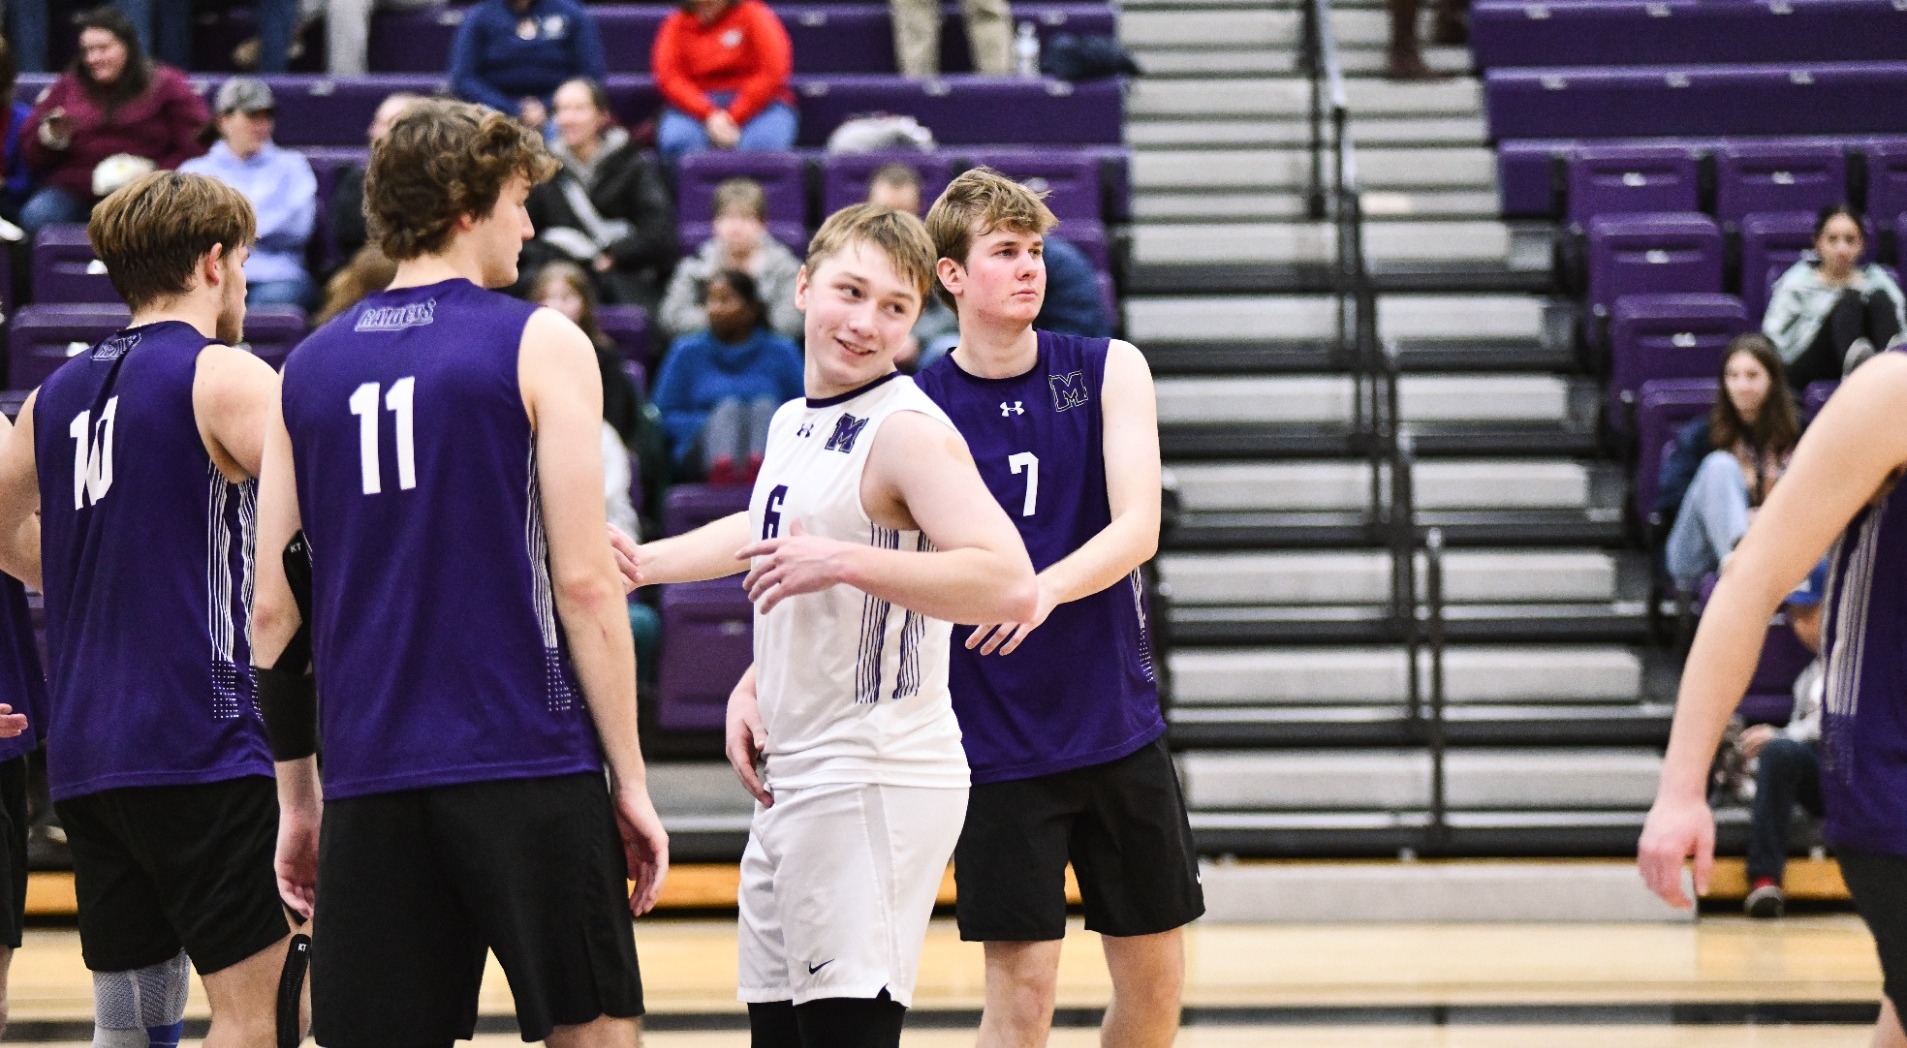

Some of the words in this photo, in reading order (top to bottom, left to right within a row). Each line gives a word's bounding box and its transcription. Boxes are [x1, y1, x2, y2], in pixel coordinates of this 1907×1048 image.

[1048, 370, 1088, 412] M
[70, 395, 118, 510] 10
[349, 376, 416, 495] 11
[824, 412, 869, 454] M
[762, 484, 788, 541] 6
[1008, 451, 1039, 517] 7
[298, 943, 307, 952] KT
